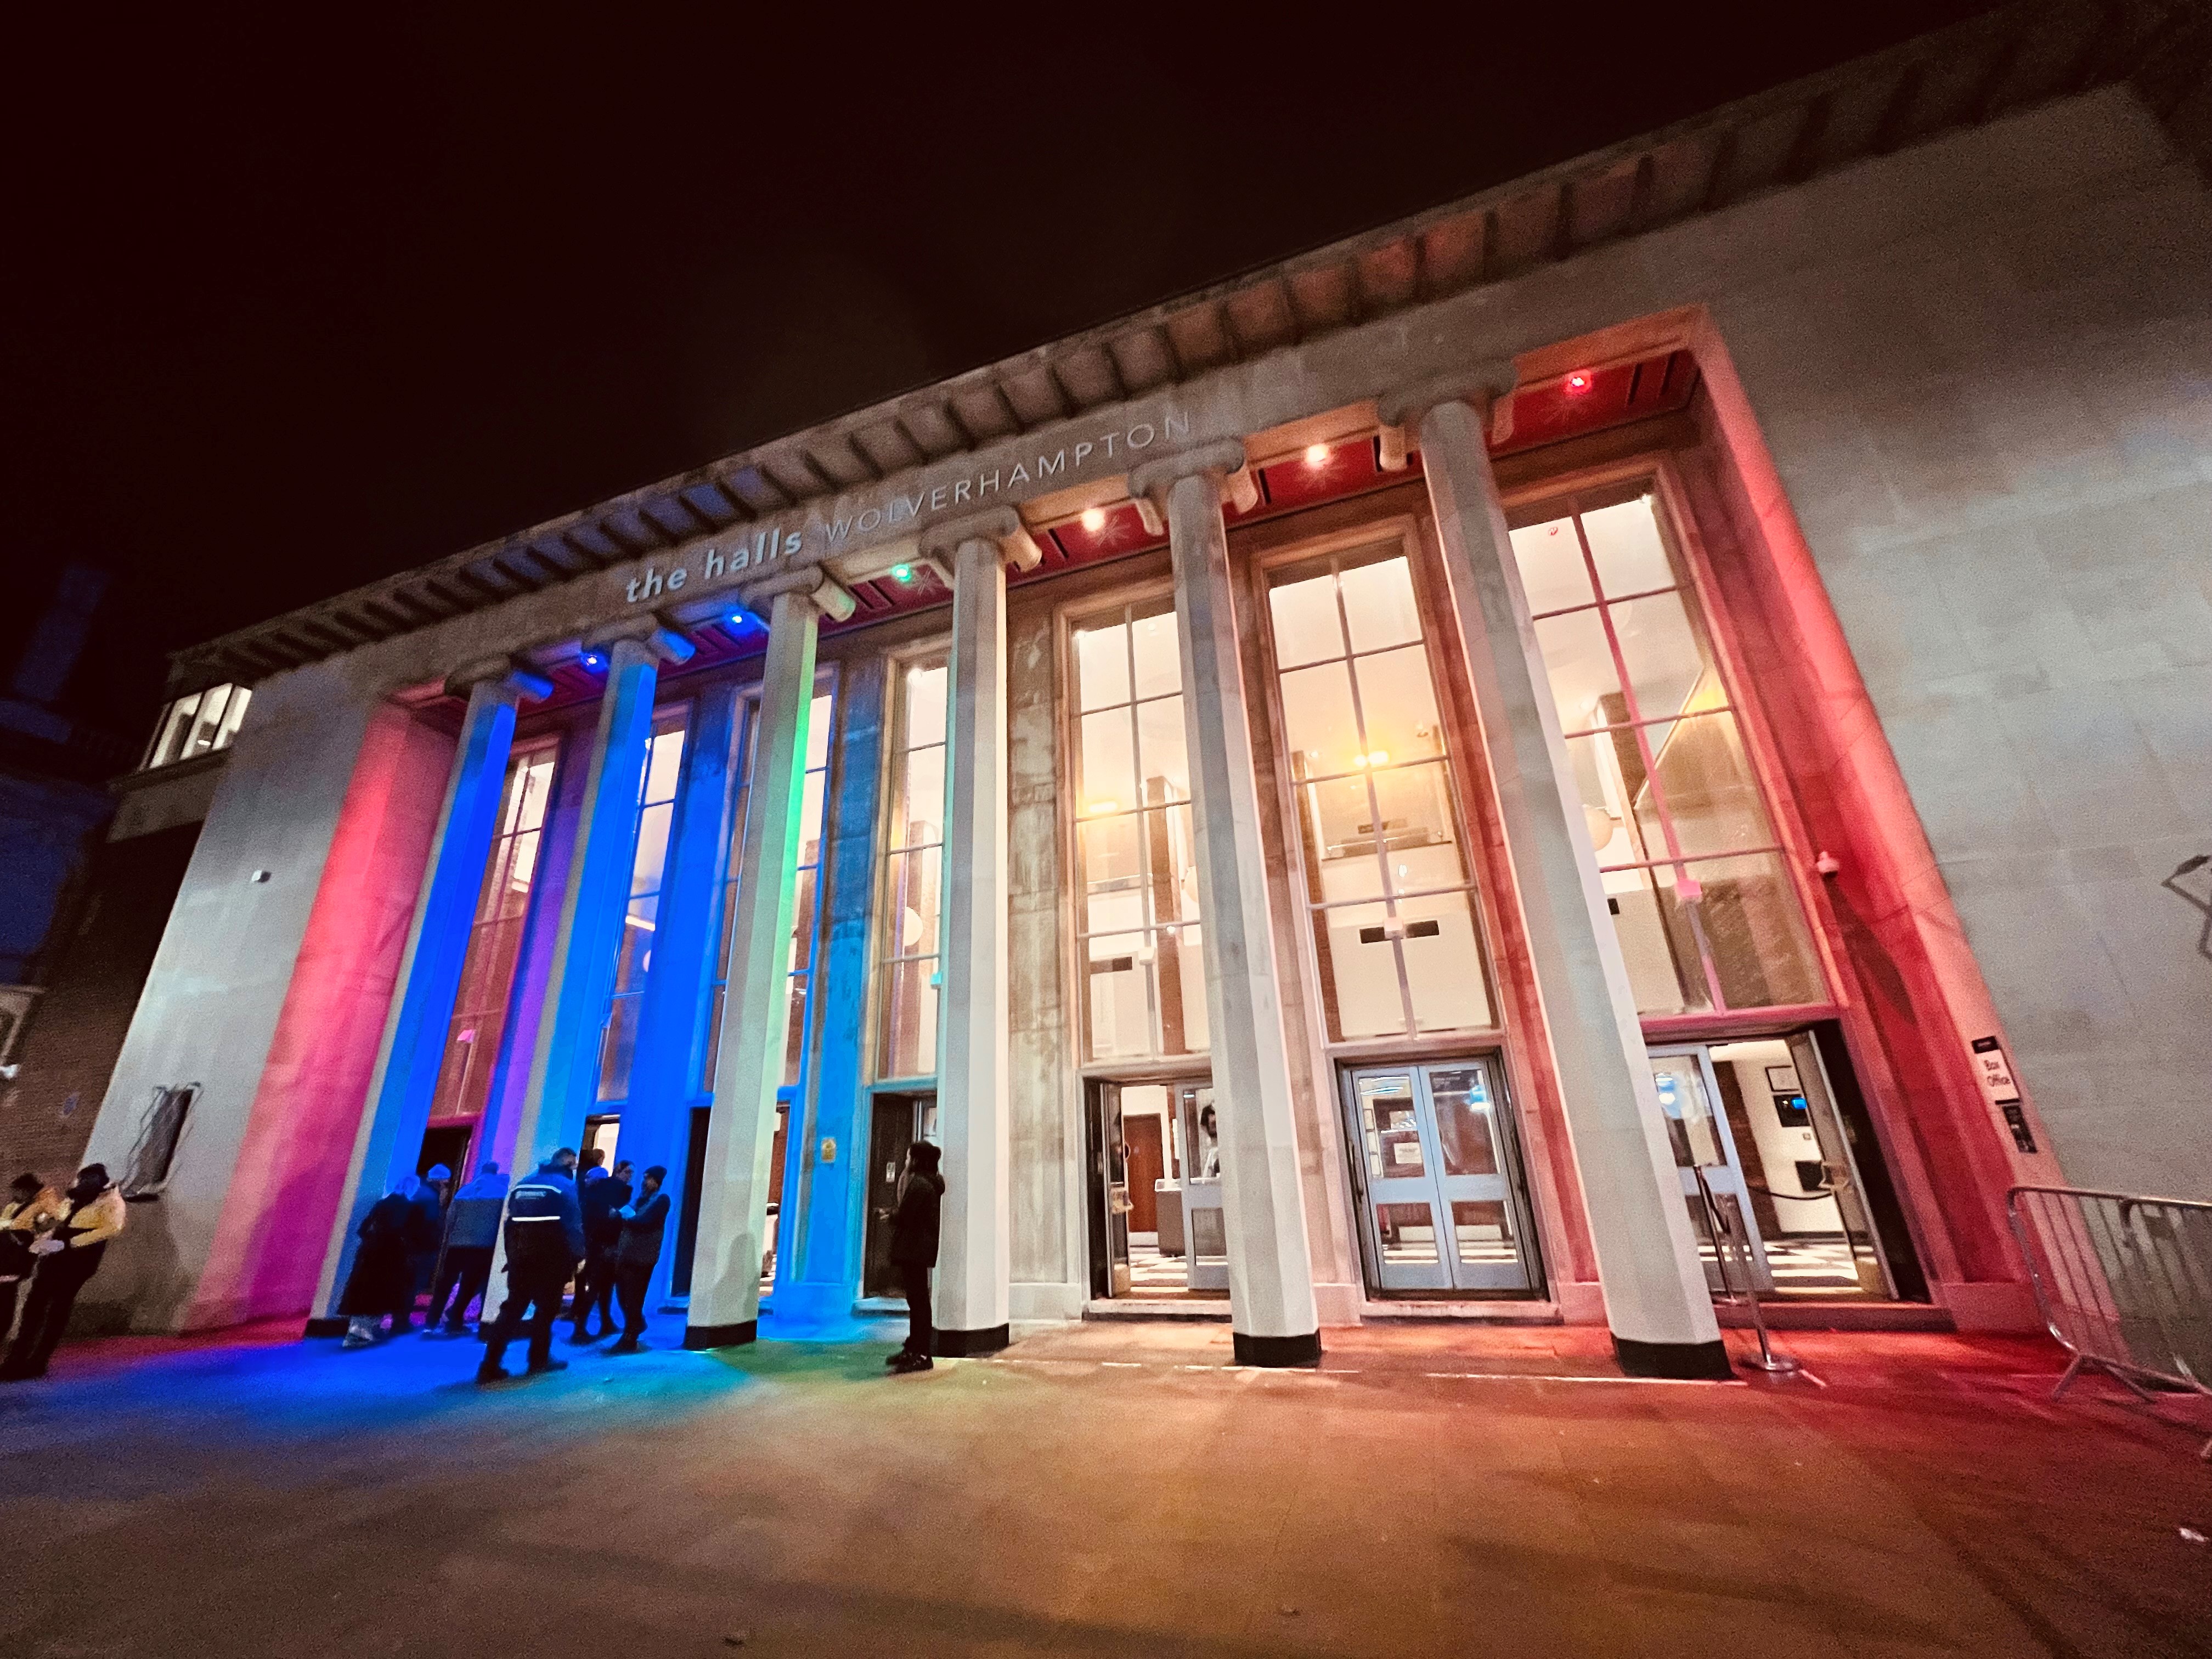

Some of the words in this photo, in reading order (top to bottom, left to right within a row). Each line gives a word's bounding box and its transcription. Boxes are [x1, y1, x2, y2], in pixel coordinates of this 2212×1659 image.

[627, 568, 687, 602] the
[705, 527, 803, 579] halls
[825, 411, 1190, 542] WOLVERHAMPTON
